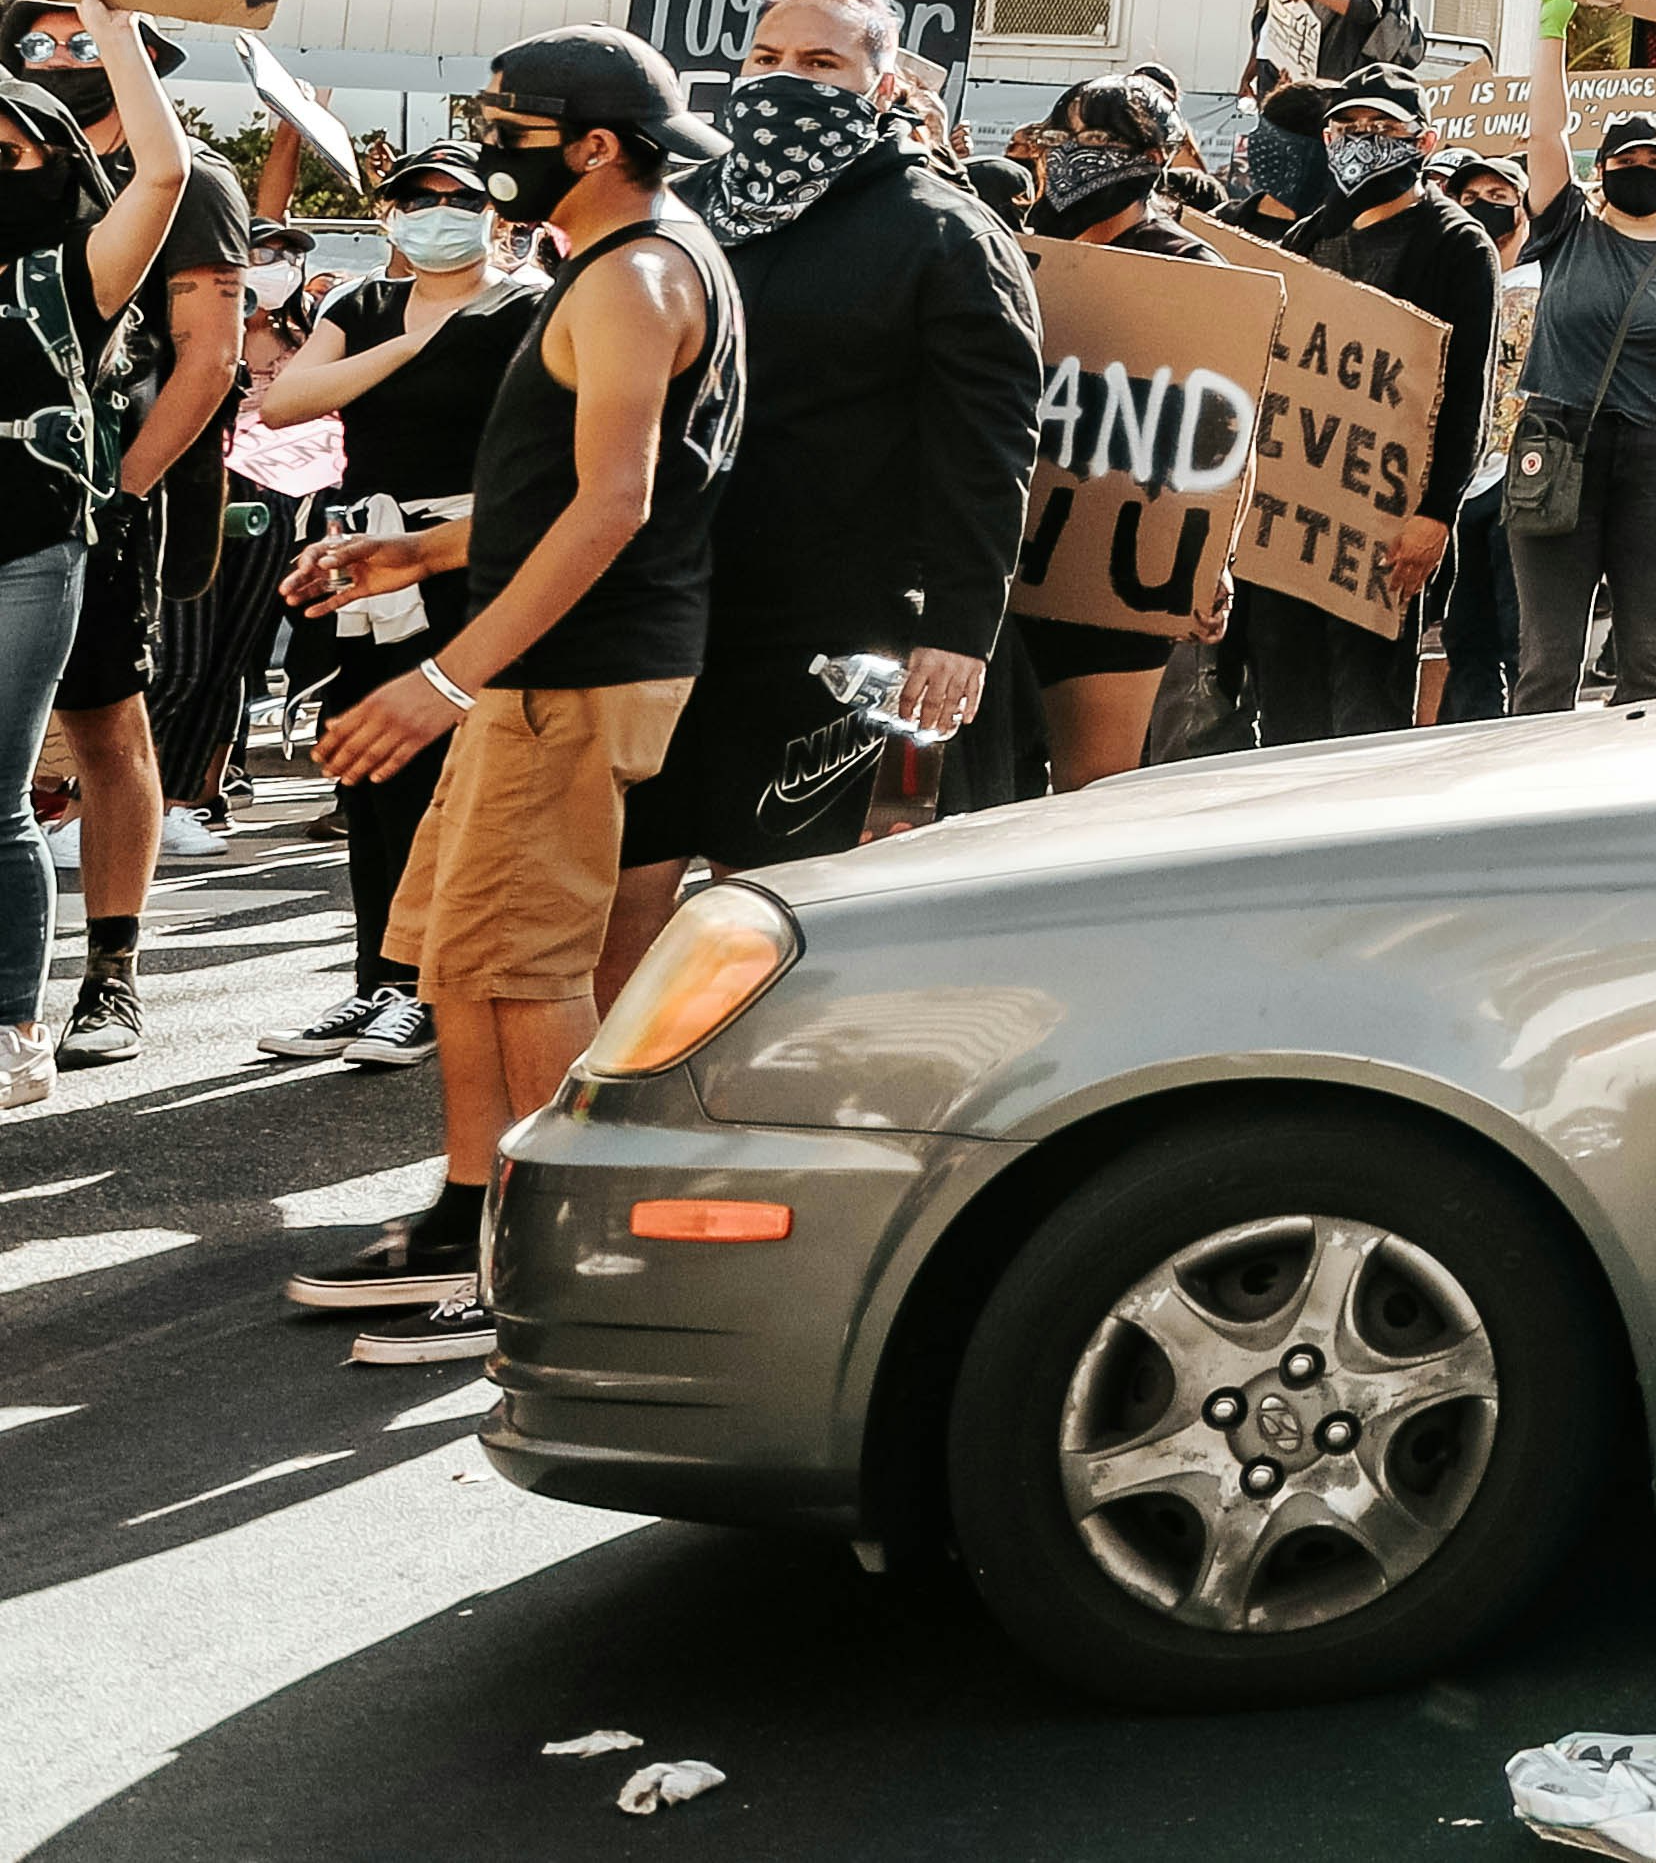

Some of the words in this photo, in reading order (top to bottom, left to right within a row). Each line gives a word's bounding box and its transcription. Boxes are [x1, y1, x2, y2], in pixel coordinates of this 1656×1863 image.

[1432, 113, 1476, 139] THE
[1471, 82, 1496, 104] IS
[1507, 82, 1530, 103] TH
[1568, 77, 1656, 99] ANGUAGE
[1271, 321, 1406, 410] LACK
[1256, 391, 1410, 518] IVES
[780, 711, 884, 790] NIK
